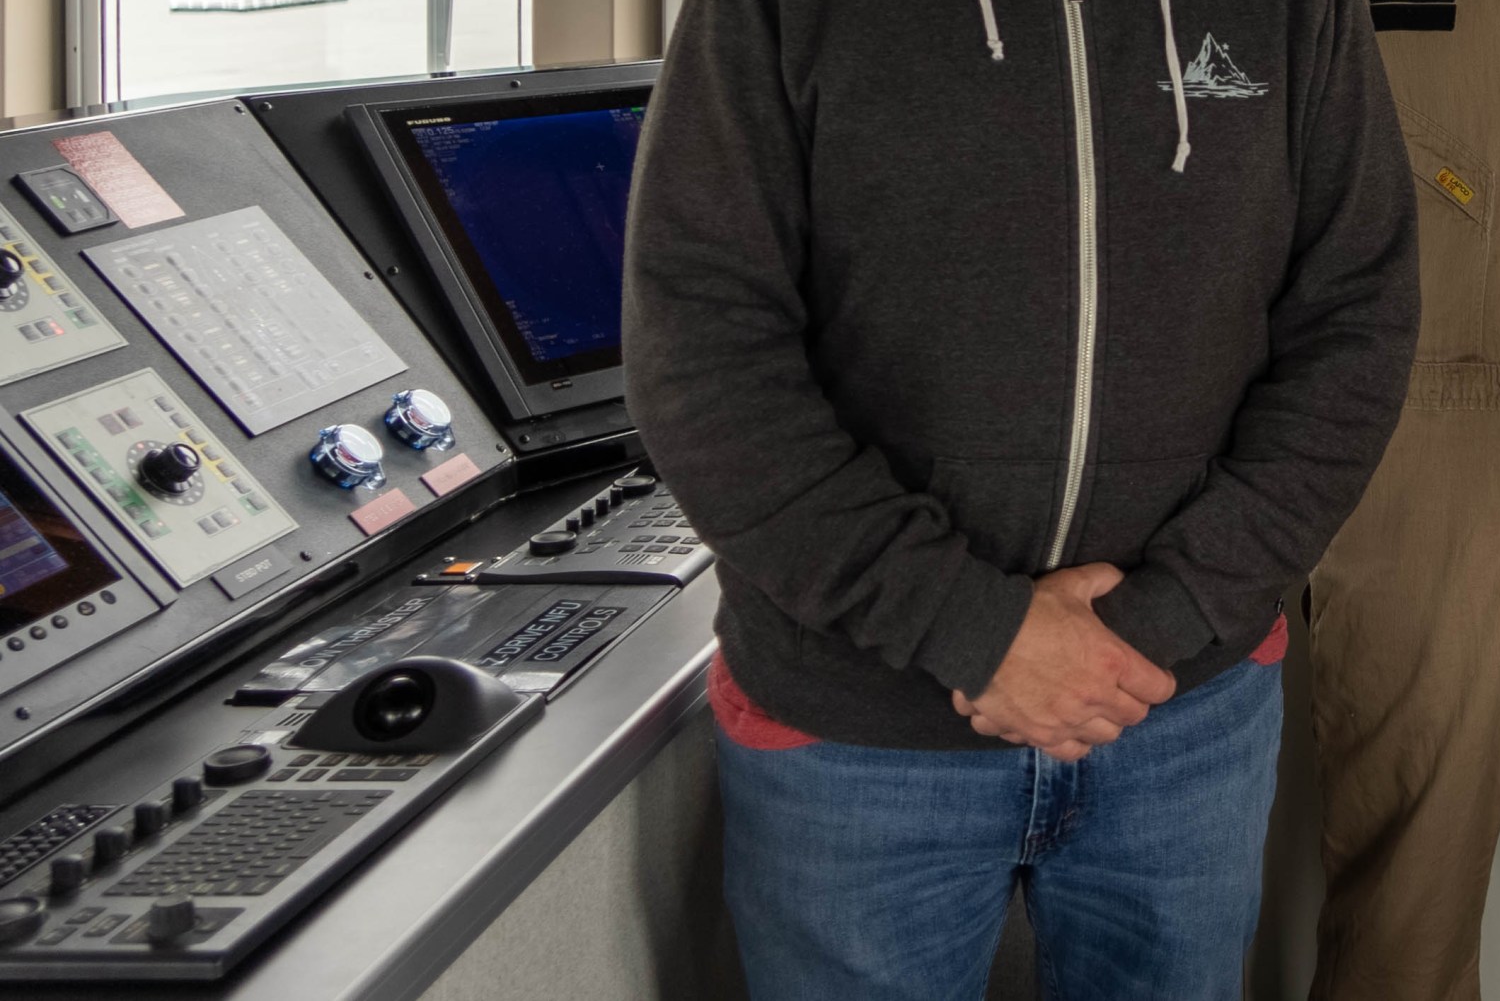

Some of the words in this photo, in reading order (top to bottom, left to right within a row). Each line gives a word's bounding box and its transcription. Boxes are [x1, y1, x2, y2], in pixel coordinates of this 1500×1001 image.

[329, 597, 434, 649] THRUSTER
[480, 622, 554, 667] Z-DRIVE
[539, 601, 582, 623] NFU
[534, 608, 618, 662] CONTROLS
